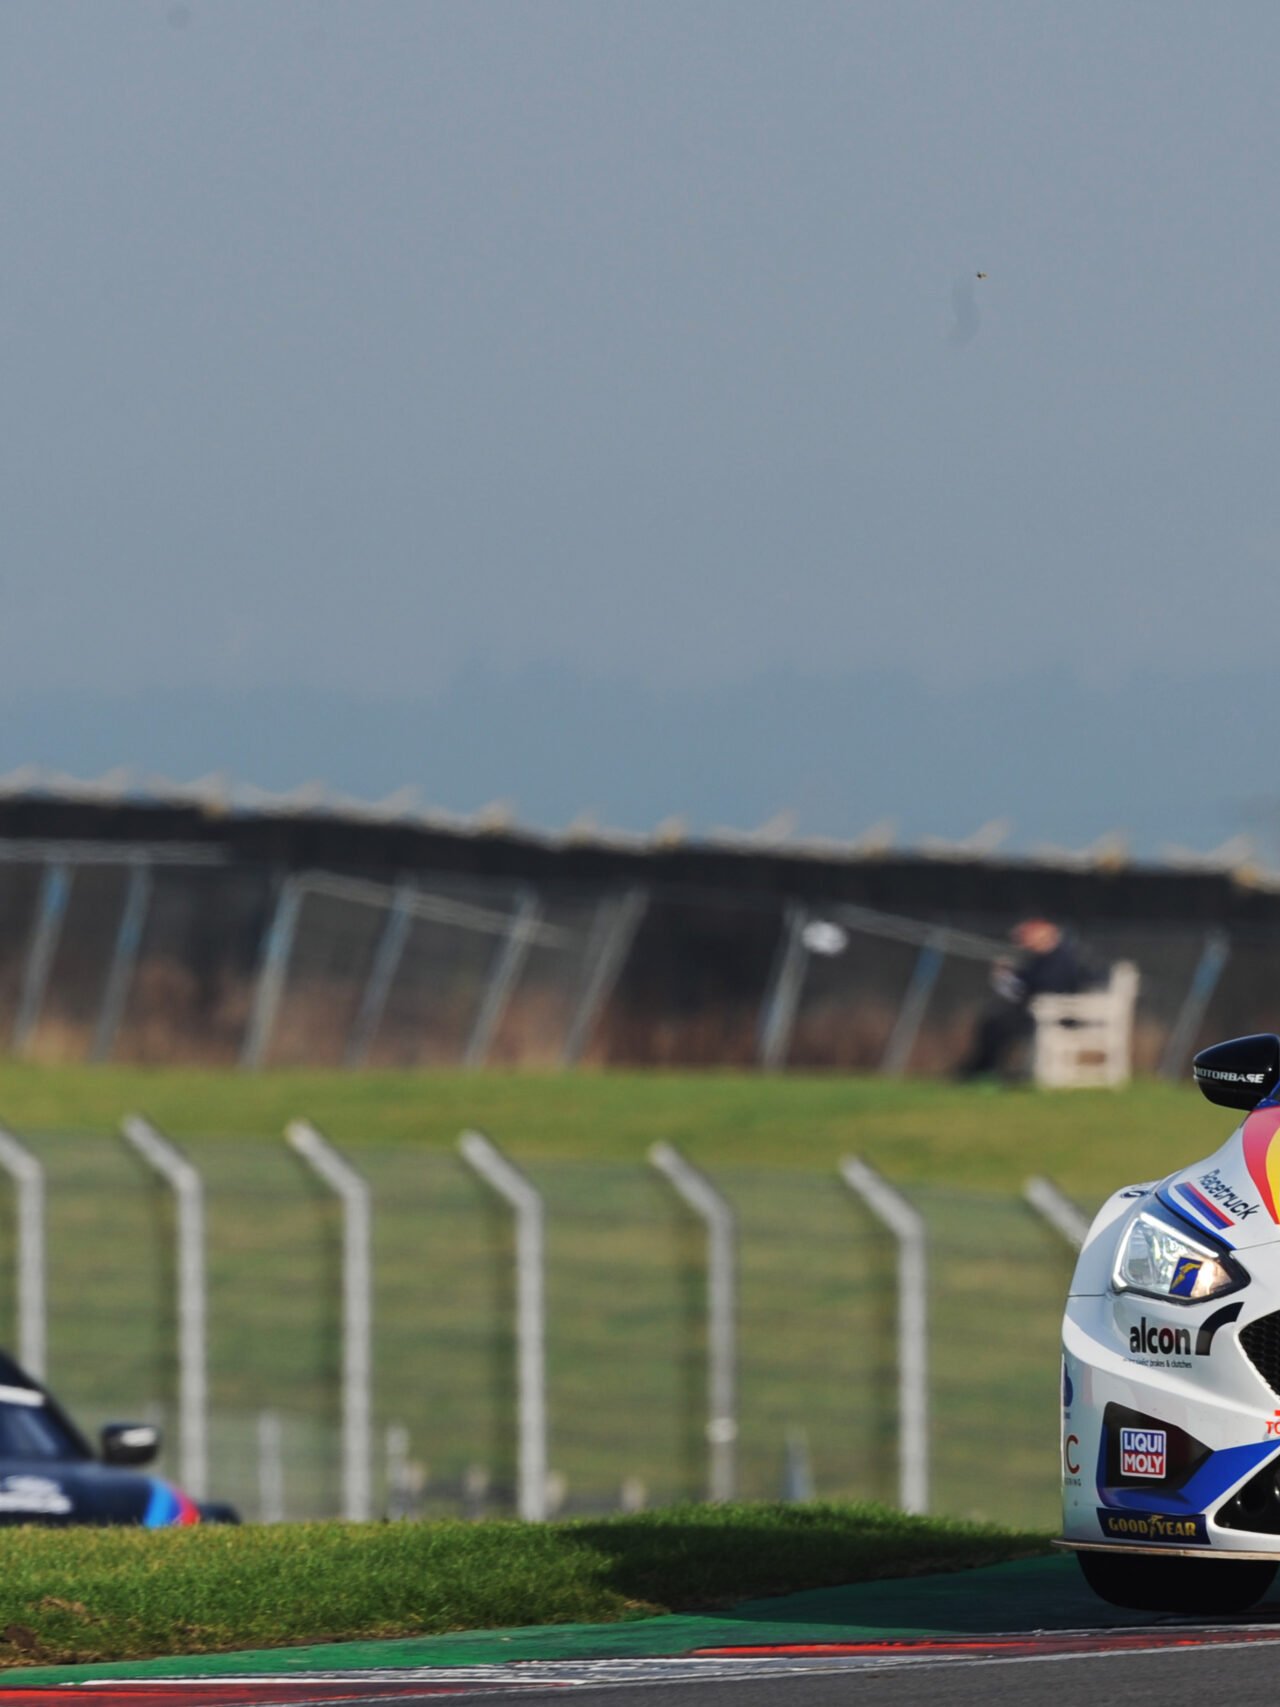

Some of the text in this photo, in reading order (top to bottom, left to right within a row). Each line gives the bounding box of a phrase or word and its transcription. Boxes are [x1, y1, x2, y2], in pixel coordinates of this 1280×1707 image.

[1200, 1169, 1258, 1221] Racetruck
[1129, 1316, 1192, 1354] alcon
[1123, 1432, 1162, 1453] LIQUI
[1123, 1453, 1164, 1473] MOLY
